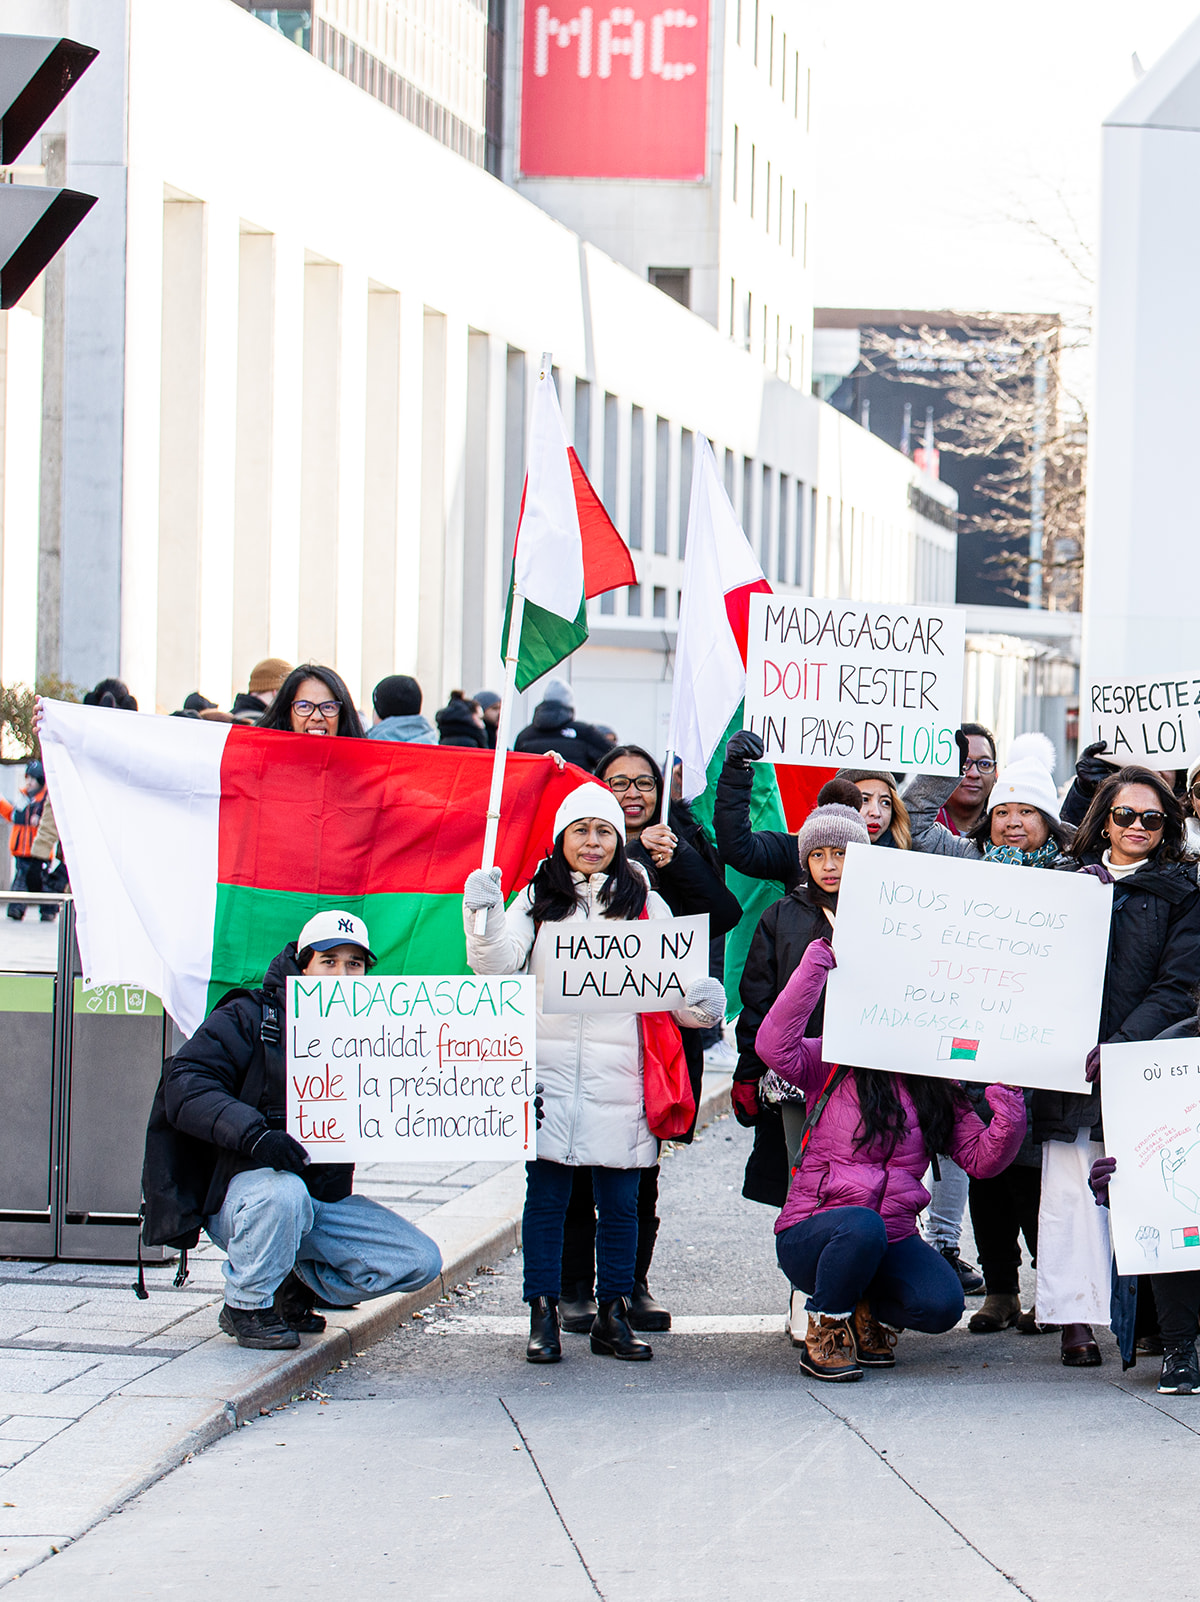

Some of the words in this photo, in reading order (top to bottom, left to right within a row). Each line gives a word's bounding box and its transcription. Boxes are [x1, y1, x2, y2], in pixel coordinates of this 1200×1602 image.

[534, 5, 697, 81] MAC
[765, 604, 945, 656] MADAGASCAR
[763, 658, 828, 701] DOIT
[838, 664, 939, 711] RESTER
[800, 717, 854, 757] PAYS
[864, 721, 893, 762] DE
[900, 723, 953, 766] LOIS
[1098, 725, 1133, 755] LA
[1142, 714, 1186, 754] LOI
[338, 918, 354, 933] NY
[879, 881, 950, 911] NOUS
[963, 899, 1068, 930] VOULONS
[556, 934, 642, 960] HAJAO
[661, 930, 695, 960] NY
[881, 917, 923, 941] DES
[941, 925, 1053, 957] ÉLECTIONS
[562, 965, 686, 998] LALÀNA
[928, 960, 1028, 993] JUSTES
[294, 979, 526, 1018] MADAGASCAR
[904, 985, 960, 1007] POUR
[980, 998, 1012, 1014] UN
[860, 1004, 985, 1034] MADAGASCAR
[1000, 1023, 1055, 1045] LIBRE
[293, 1025, 321, 1058] Le
[331, 1024, 431, 1058] candidat
[436, 1022, 524, 1068] français
[293, 1063, 344, 1100] vole
[358, 1063, 380, 1097] la
[390, 1065, 505, 1112] présidence
[511, 1061, 536, 1097] et
[1143, 1063, 1162, 1081] OÙ
[1170, 1065, 1188, 1077] EST
[296, 1105, 344, 1140] tue
[359, 1104, 384, 1138] la
[395, 1104, 517, 1138] démocratie
